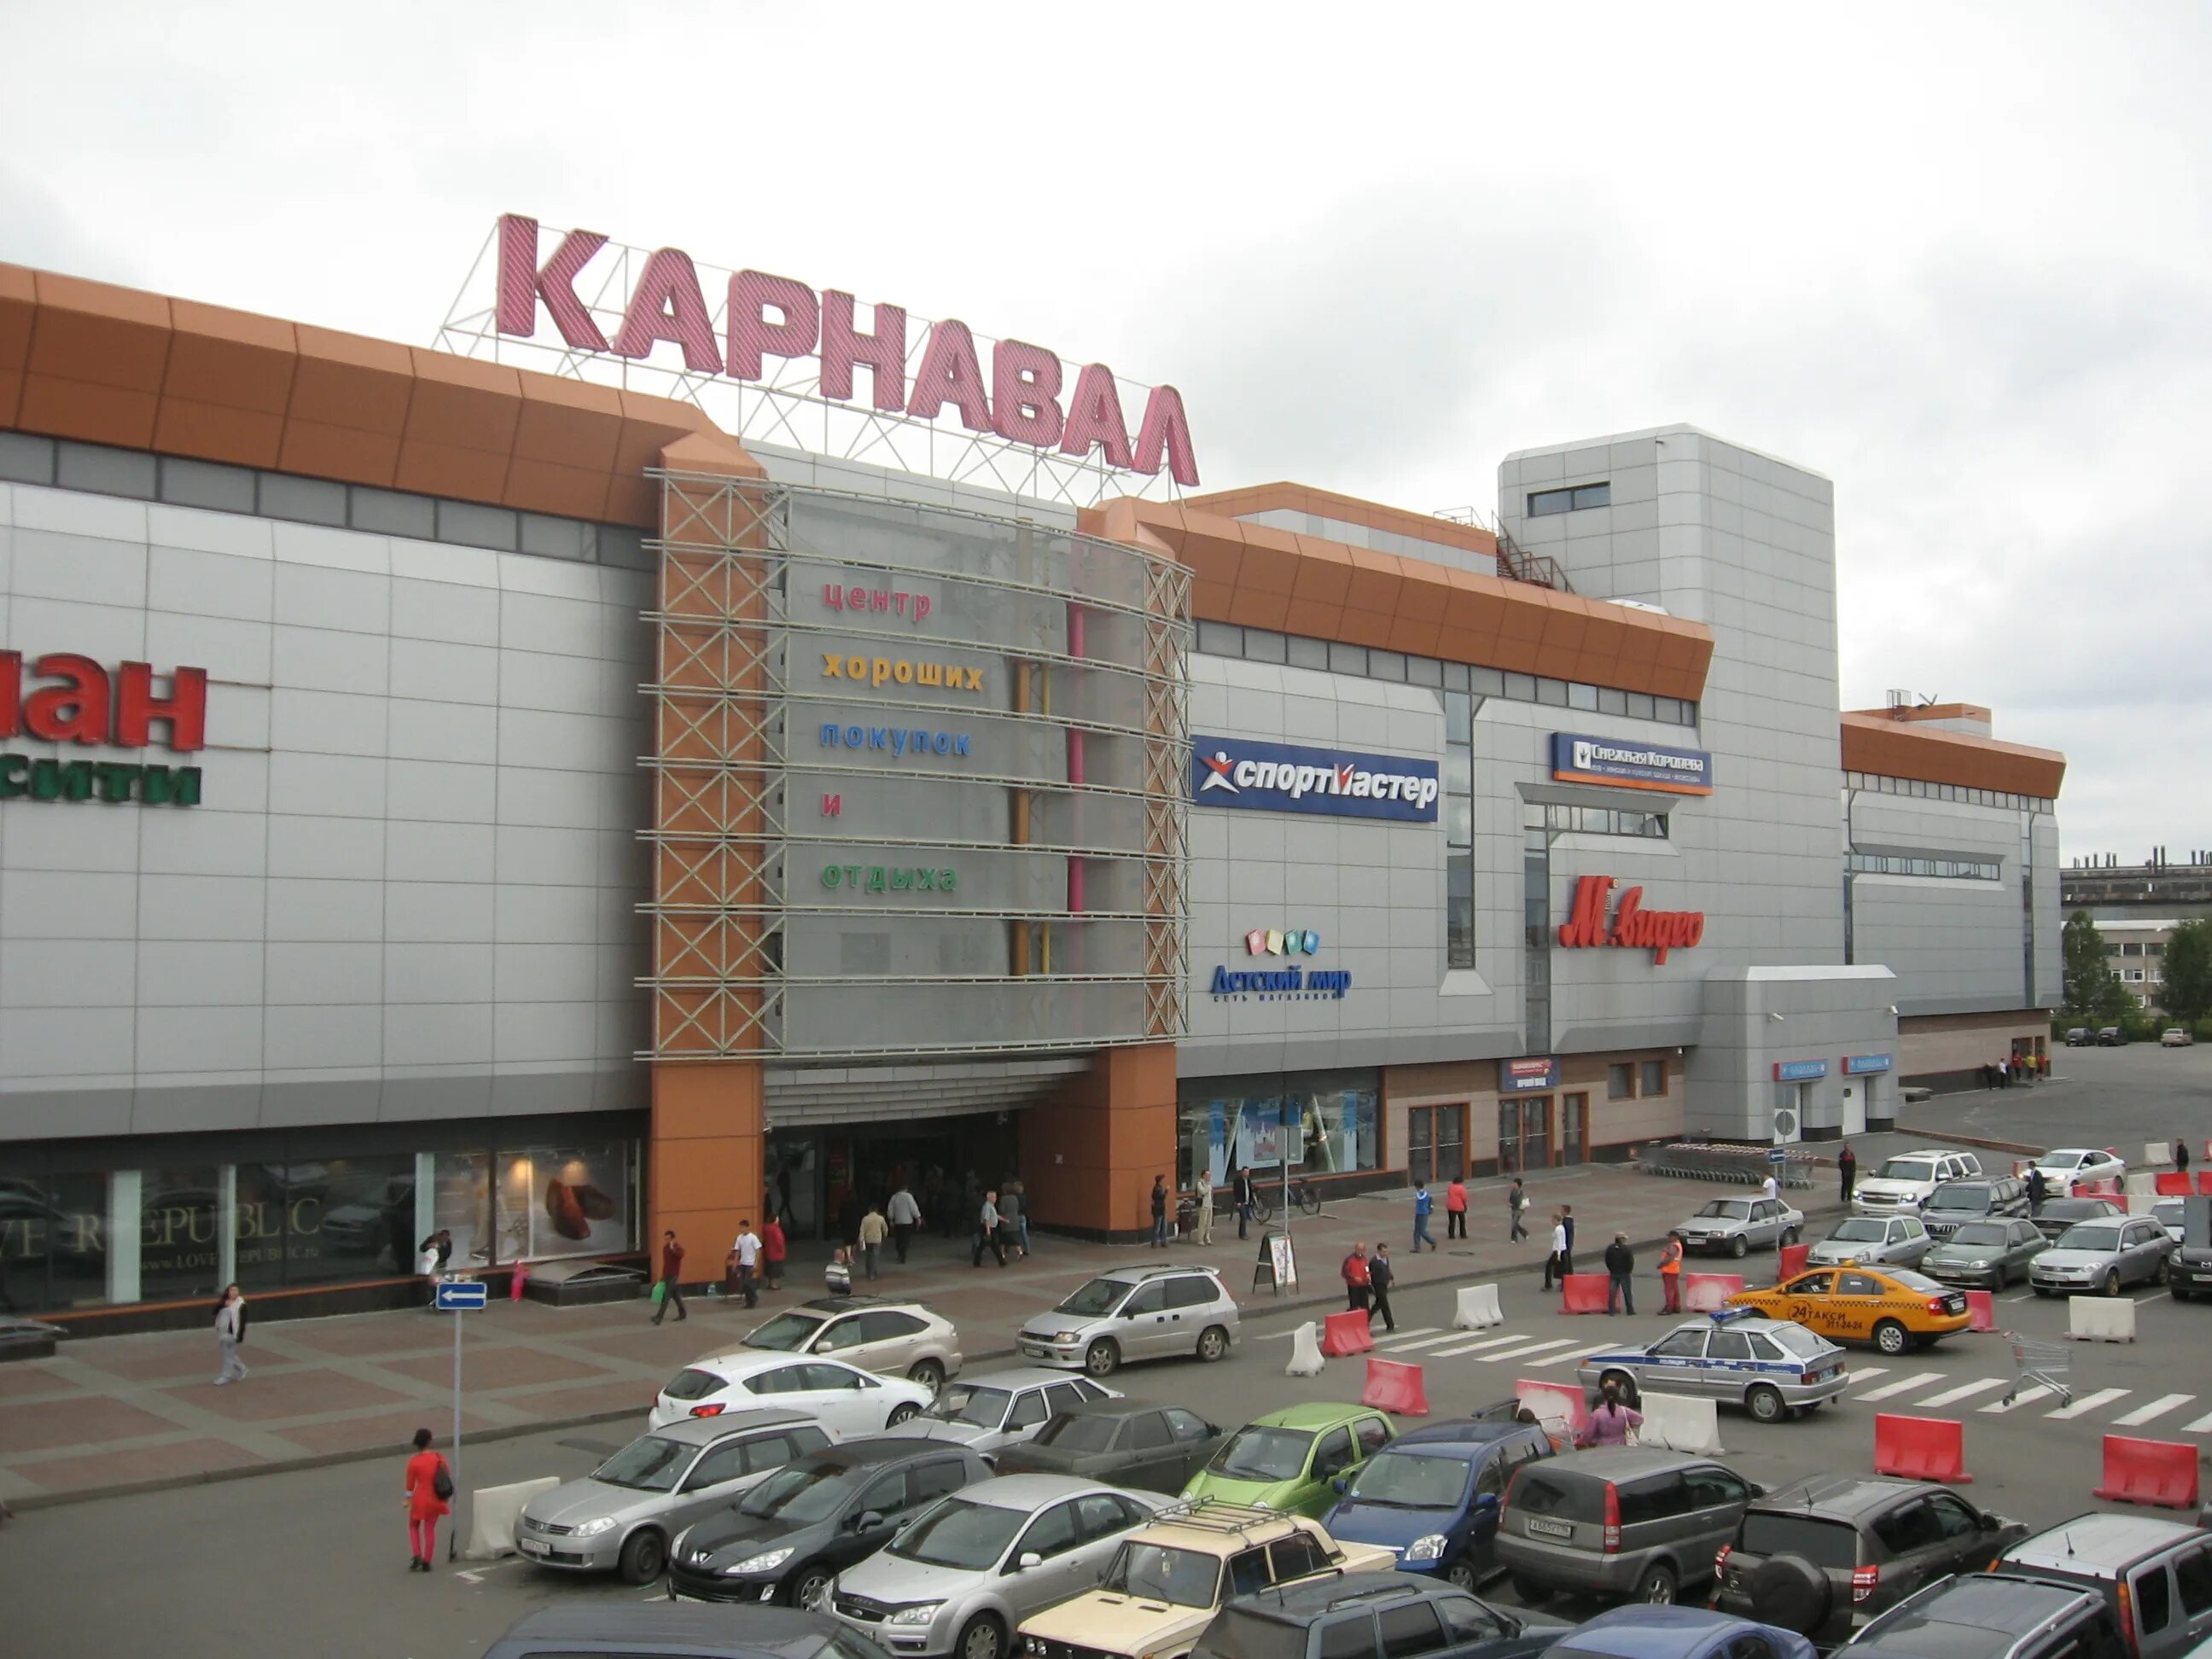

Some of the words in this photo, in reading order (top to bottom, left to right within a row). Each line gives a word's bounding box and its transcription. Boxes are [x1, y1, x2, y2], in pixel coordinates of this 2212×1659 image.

[496, 212, 1201, 487] КАРНАВАЛ
[822, 582, 932, 622] центр
[821, 653, 984, 691] хороших
[821, 723, 973, 757] покупок
[821, 791, 841, 817] и
[820, 863, 958, 894] отдыха
[1211, 964, 1304, 994] Детский
[1308, 969, 1353, 998] мир
[1792, 1306, 1807, 1318] 24
[1808, 1310, 1846, 1322] ТАКСИ
